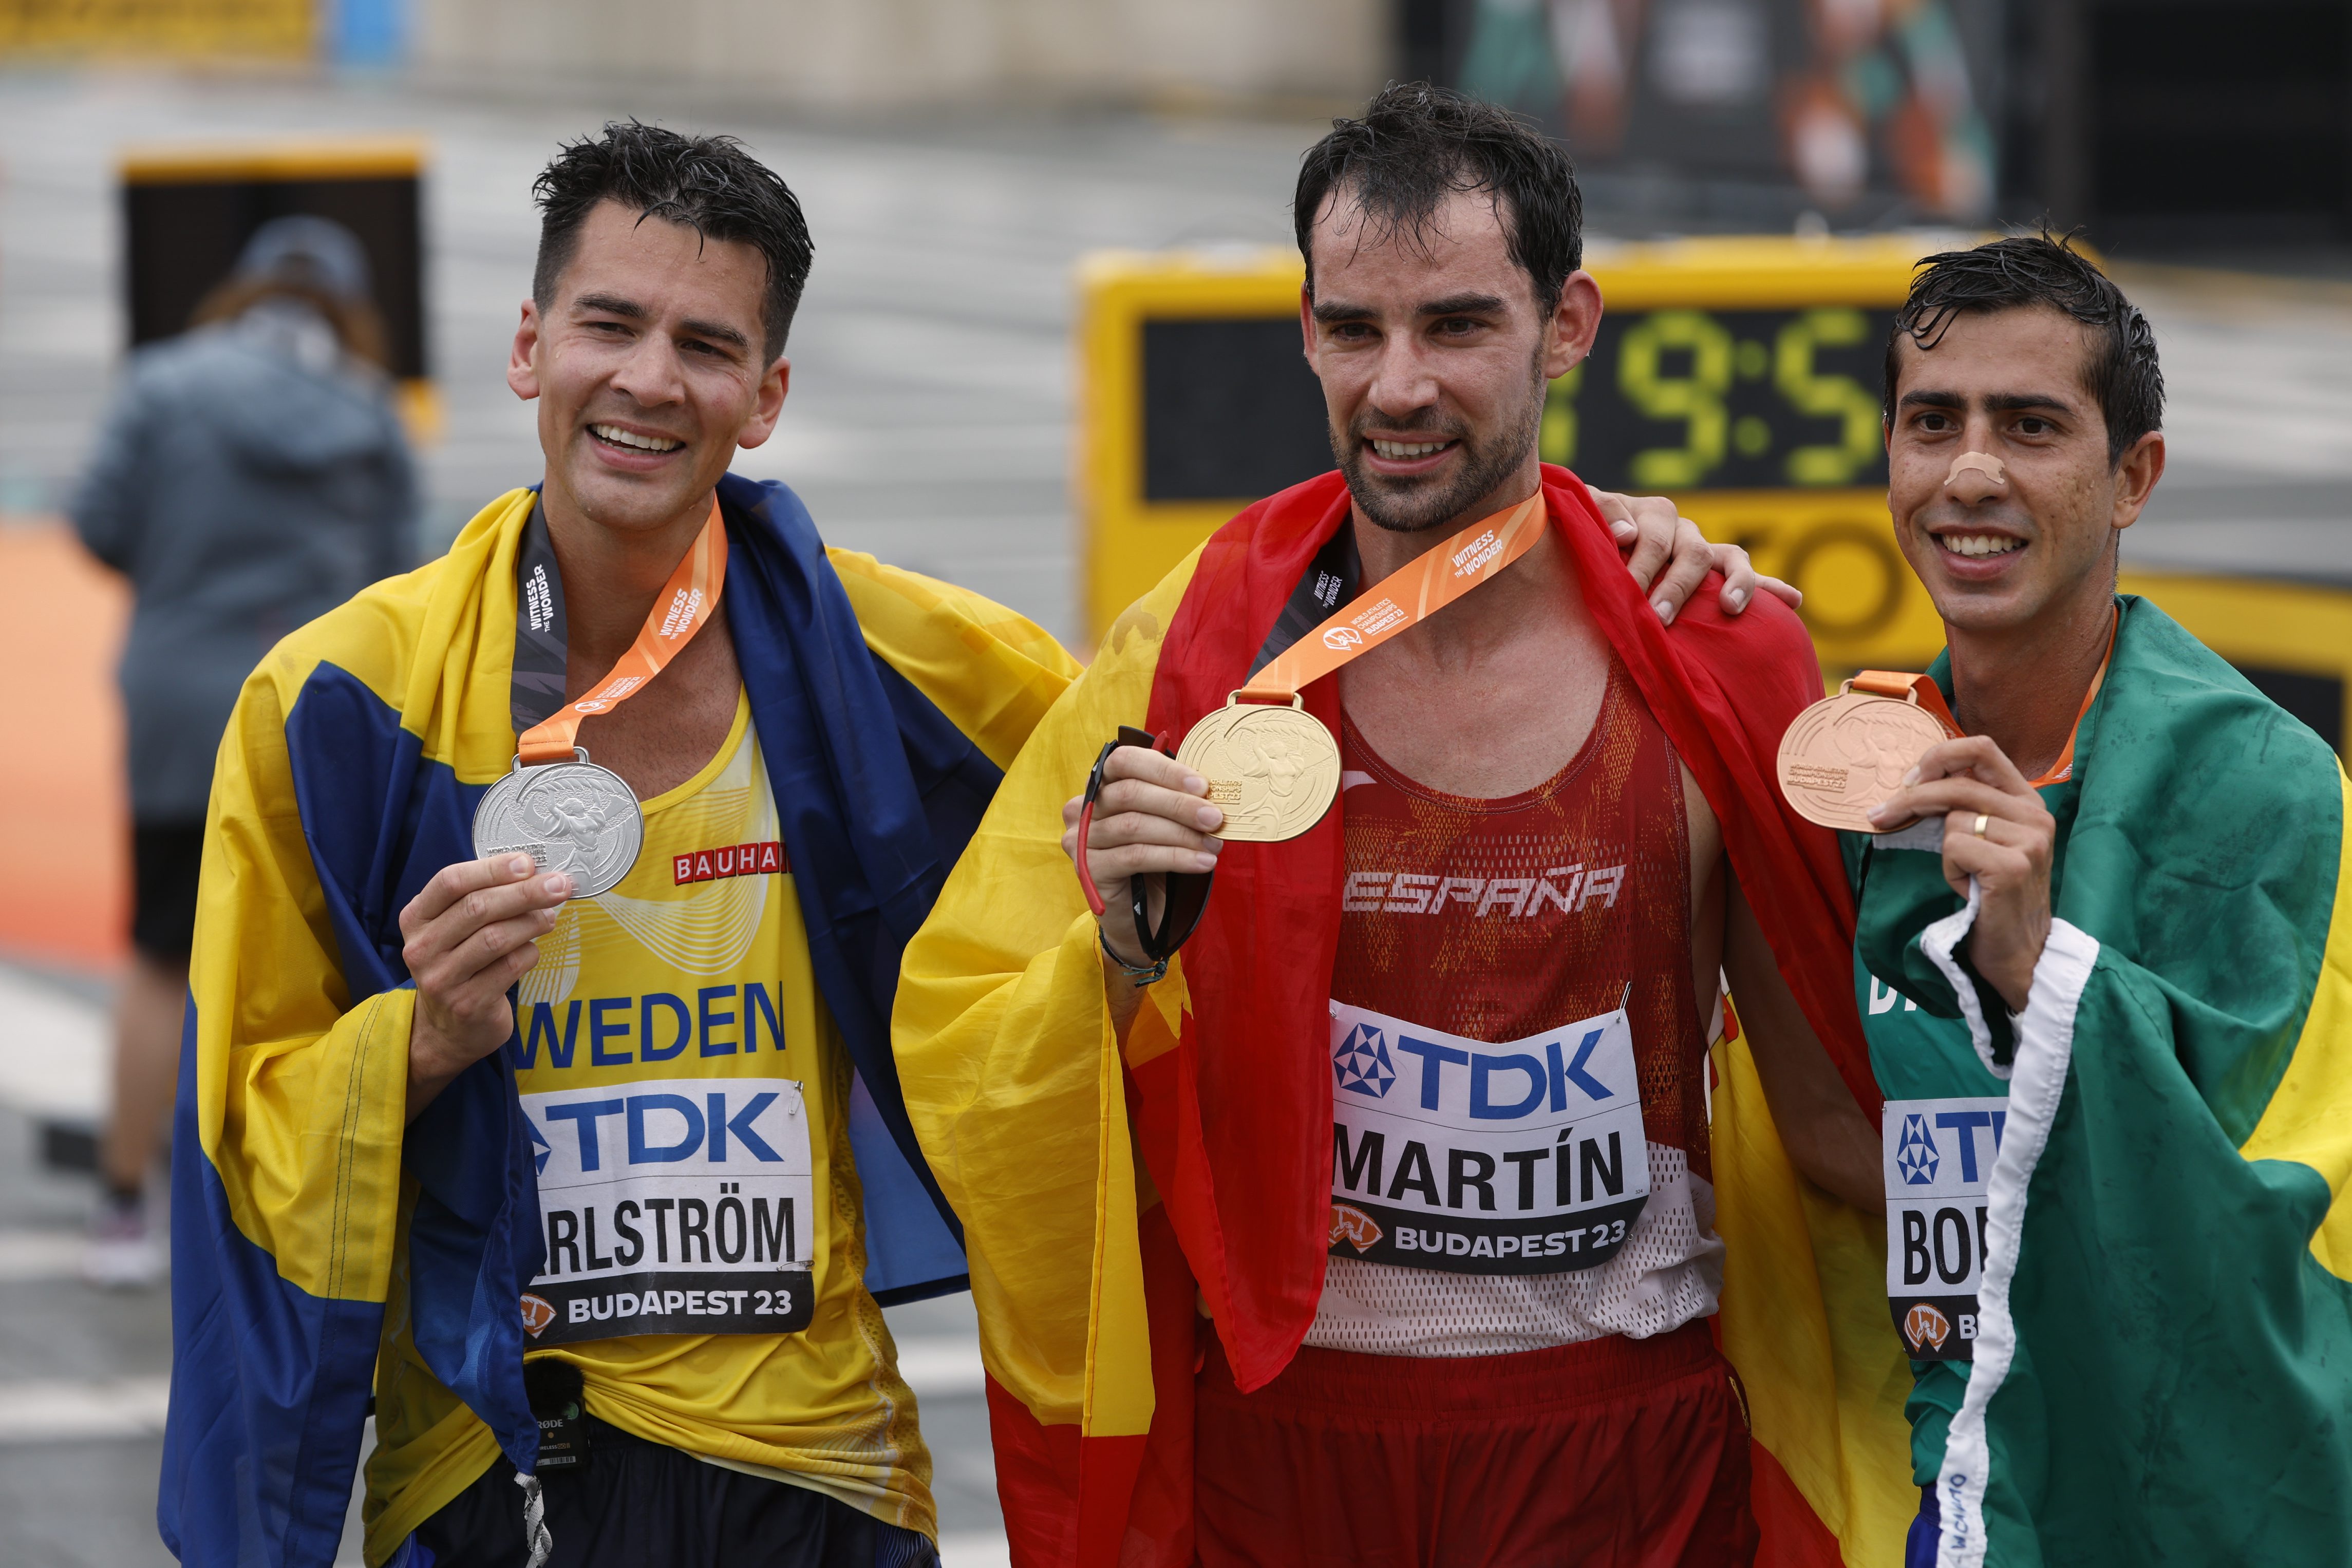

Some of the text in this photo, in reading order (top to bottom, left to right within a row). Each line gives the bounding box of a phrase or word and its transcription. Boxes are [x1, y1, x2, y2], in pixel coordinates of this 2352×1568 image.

[1452, 530, 1494, 568] WITNESS
[1455, 539, 1502, 578] THE WONDER
[526, 578, 542, 630] WITNESS
[534, 563, 554, 620] WONDER
[1314, 570, 1329, 600] WITNESS
[1325, 576, 1343, 606] WONDER
[659, 588, 688, 635] WITNESS
[674, 588, 703, 632] WONDER
[1350, 598, 1391, 625] WORLD ATHLETICS
[1357, 603, 1397, 629] CHAMPIONSHIPS
[1364, 613, 1396, 634] BUDAPEST
[1787, 774, 1833, 787] BUDAPEST
[1789, 769, 1848, 781] CHAMPIONSHIPS
[512, 843, 546, 852] ATHLETICS
[1342, 862, 1627, 917] ESPAÑA
[515, 980, 786, 1070] WEDEN
[1397, 1028, 1614, 1120] TDK
[545, 1092, 785, 1172] TDK
[1333, 1122, 1624, 1212] MARTÍN
[536, 1182, 796, 1277] RLSTRÖM
[1396, 1220, 1626, 1258] BUDAPEST 23
[569, 1290, 792, 1324] BUDAPEST 23
[537, 1419, 563, 1429] RØDE
